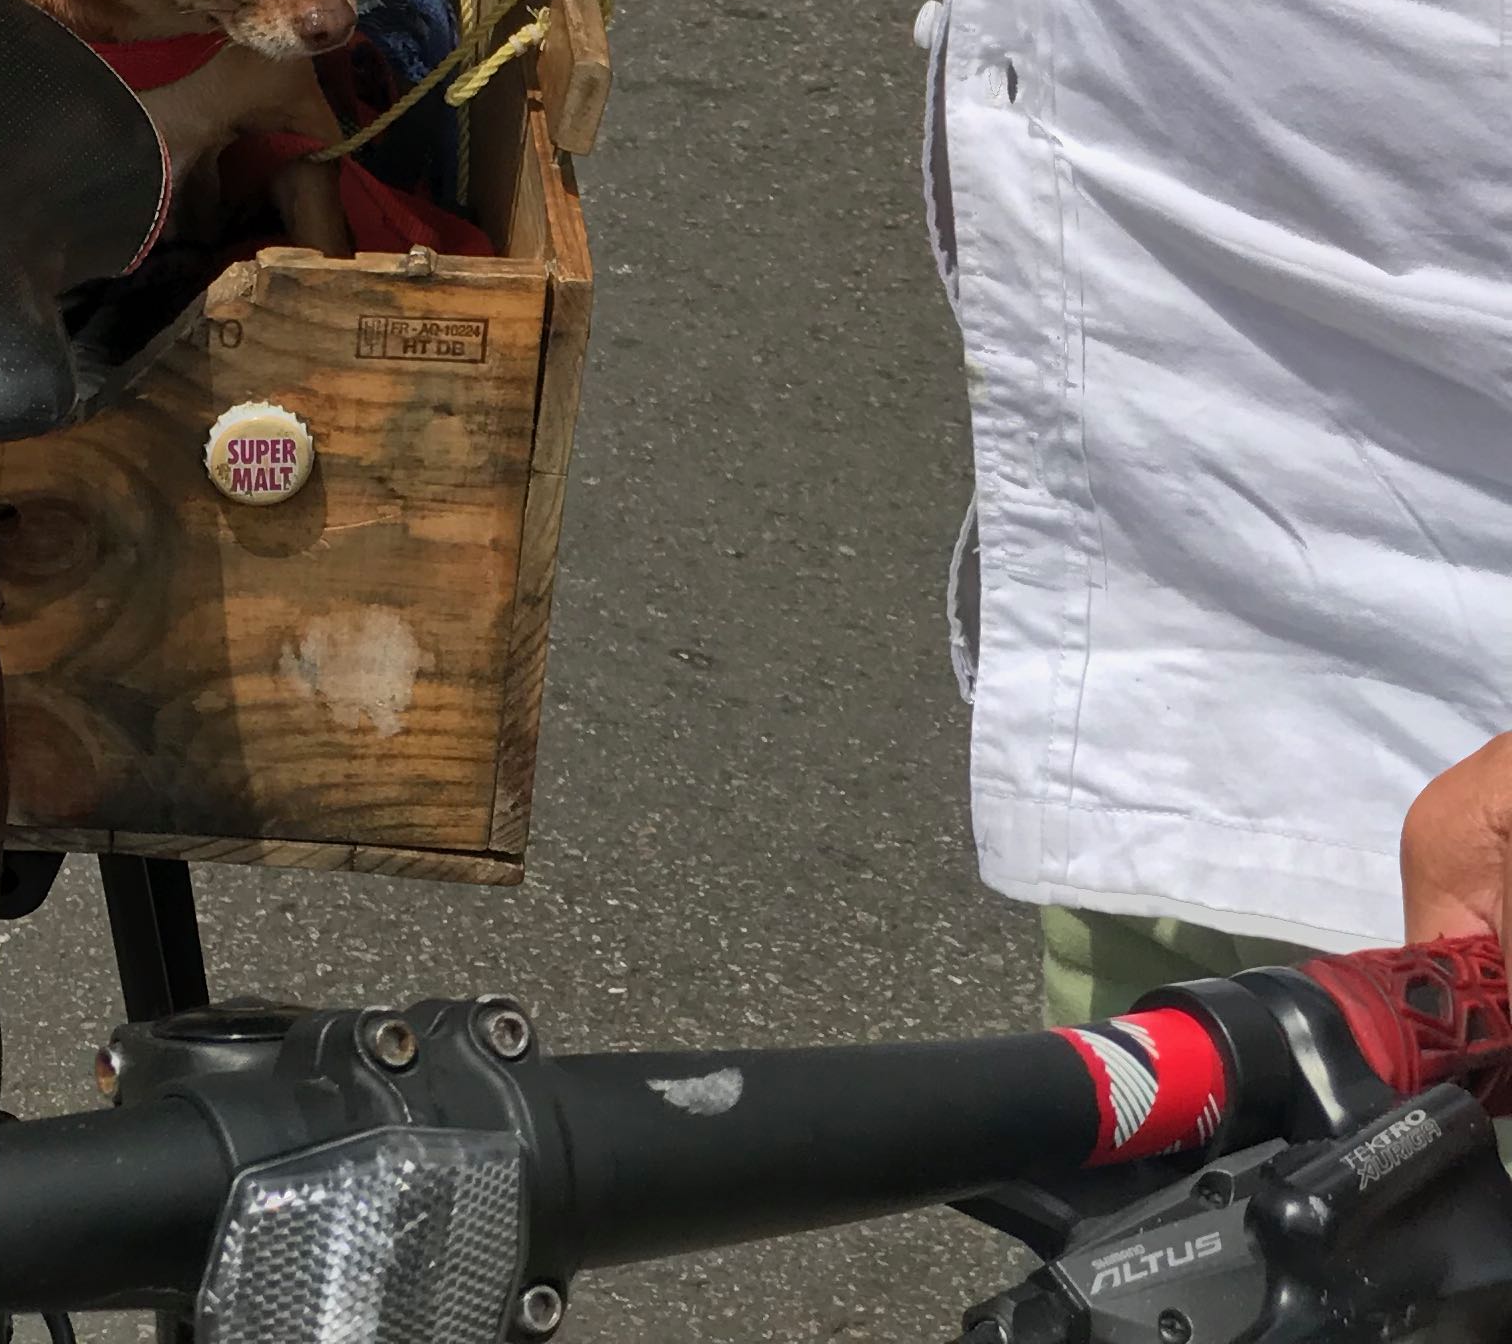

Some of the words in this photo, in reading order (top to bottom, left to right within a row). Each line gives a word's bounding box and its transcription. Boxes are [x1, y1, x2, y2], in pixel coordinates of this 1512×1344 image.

[402, 338, 432, 355] HT
[436, 340, 466, 356] DB
[227, 438, 297, 465] SUPER
[230, 466, 293, 492] MALT
[1339, 1109, 1427, 1170] TEKTRO
[1090, 1231, 1222, 1295] ALTUS
